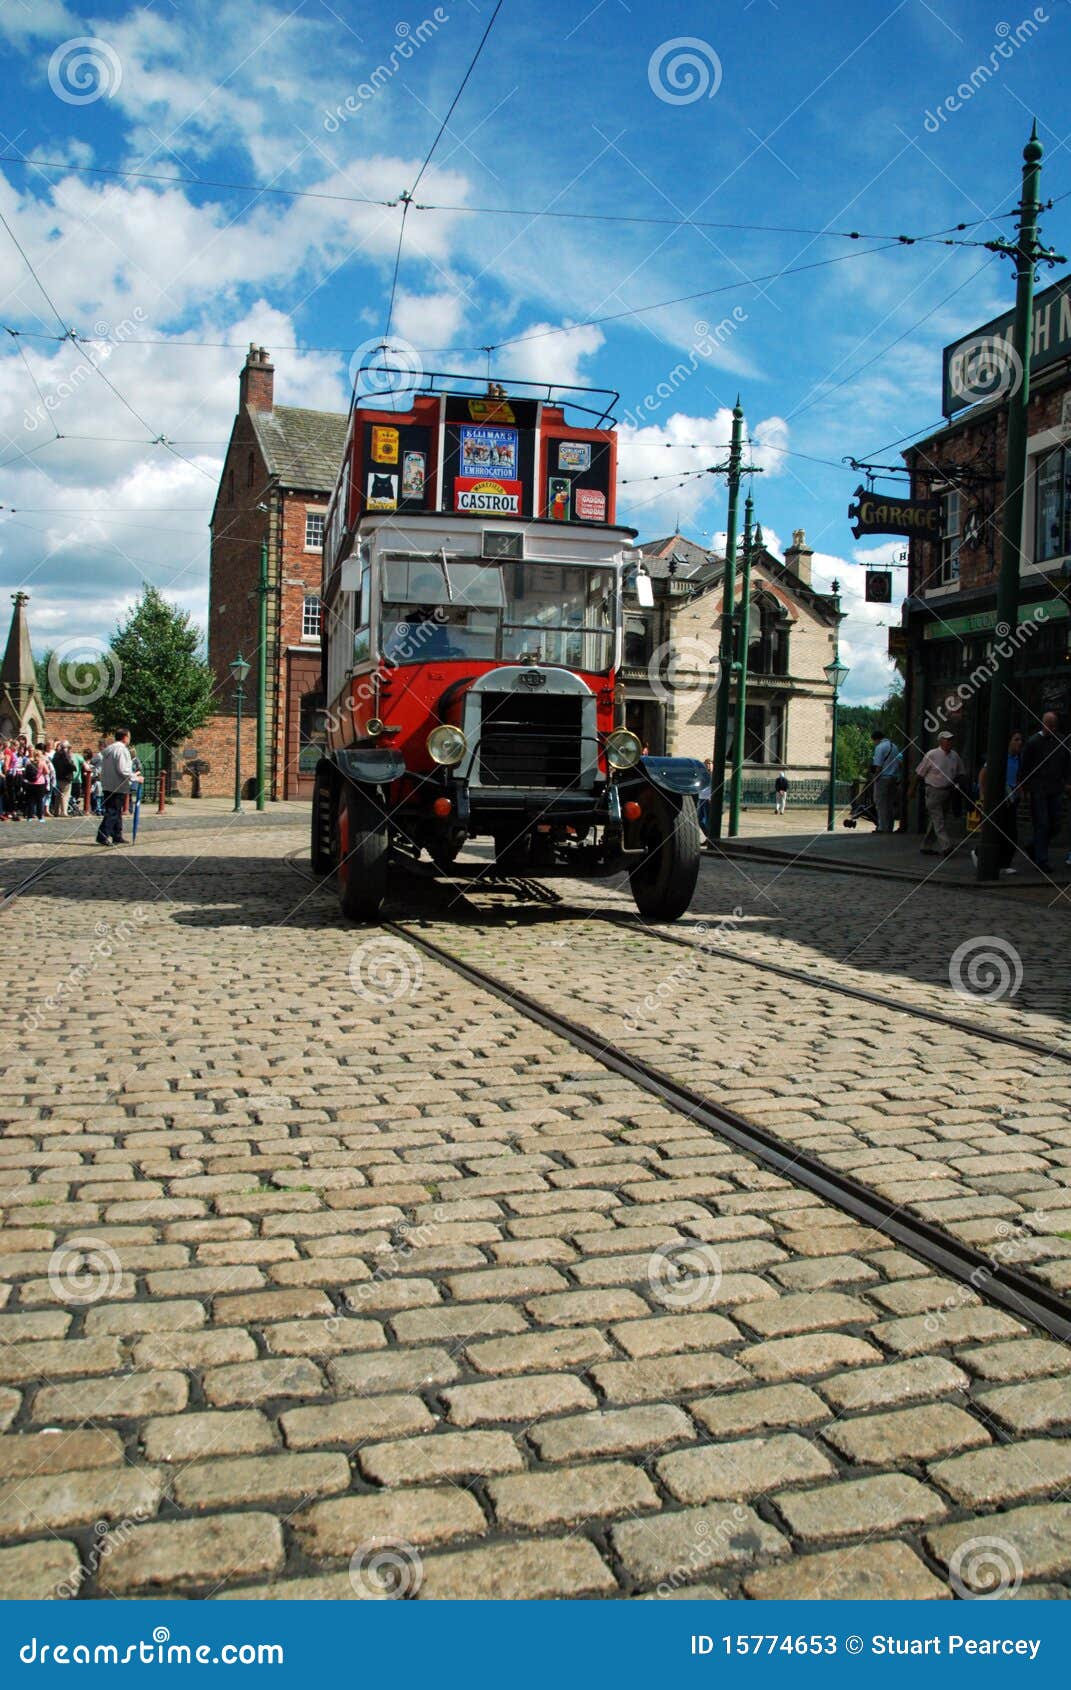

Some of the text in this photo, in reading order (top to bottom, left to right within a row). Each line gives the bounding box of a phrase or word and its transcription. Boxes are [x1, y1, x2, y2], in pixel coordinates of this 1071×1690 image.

[951, 303, 1051, 398] BEAMH
[464, 466, 513, 477] EMBROCATION
[461, 493, 517, 511] CASTROL
[860, 501, 937, 530] GARAGE
